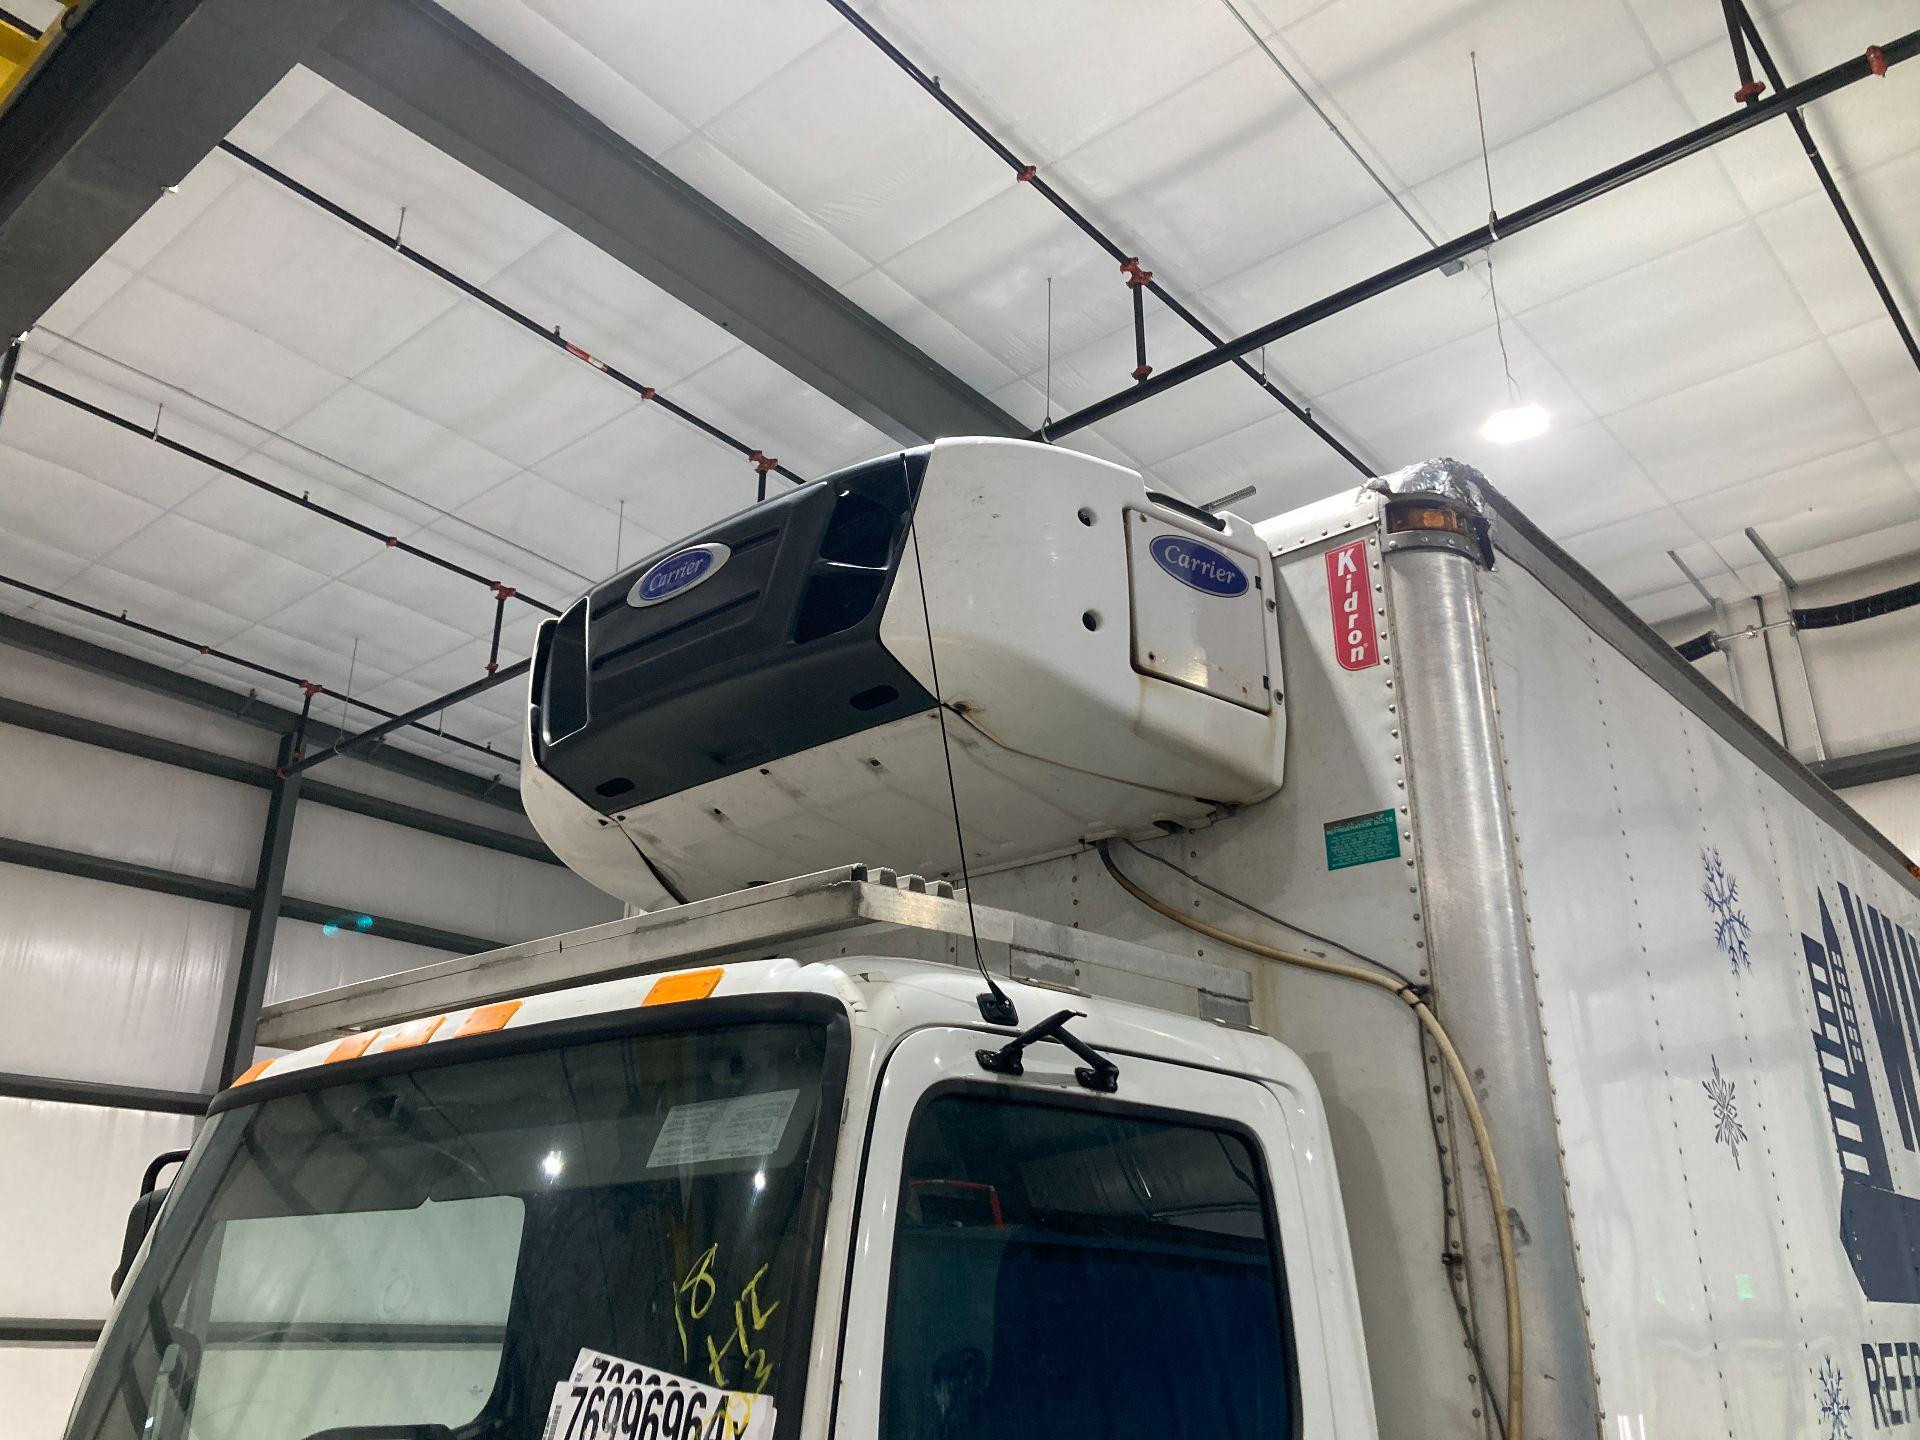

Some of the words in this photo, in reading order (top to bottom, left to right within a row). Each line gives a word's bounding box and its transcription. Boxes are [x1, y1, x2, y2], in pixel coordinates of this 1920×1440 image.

[649, 557, 704, 591] Carrier
[1164, 545, 1236, 584] Carrier
[1337, 547, 1366, 663] Kidron
